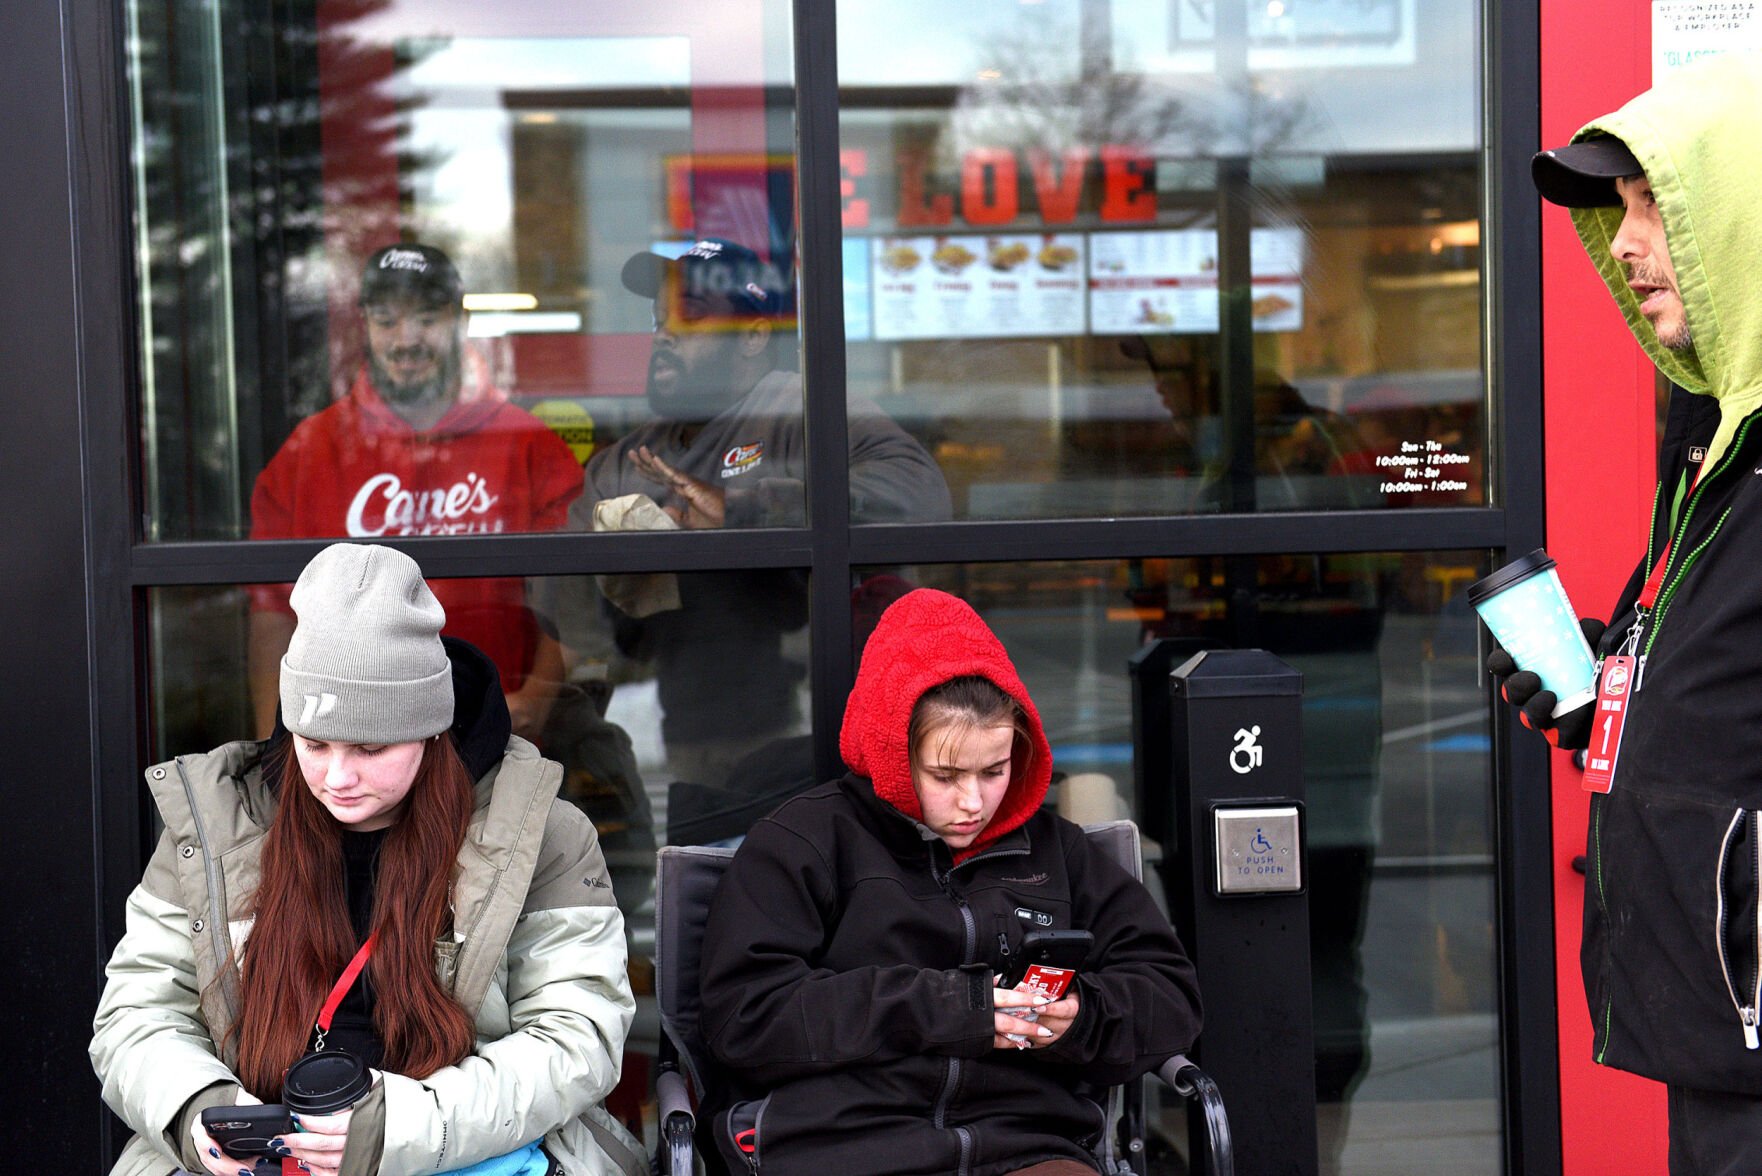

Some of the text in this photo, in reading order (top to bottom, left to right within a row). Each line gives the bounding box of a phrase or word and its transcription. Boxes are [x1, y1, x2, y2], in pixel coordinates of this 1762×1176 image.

[897, 146, 1158, 227] LOVE
[1401, 441, 1418, 452] Sun
[1426, 440, 1442, 452] Thu
[1376, 455, 1419, 466] 10:00am
[1427, 453, 1470, 465] 12:00am
[1404, 467, 1418, 479] Fri
[1424, 466, 1440, 478] Sat
[1380, 481, 1423, 493] 10:00am
[1431, 480, 1467, 492] 1:00am
[346, 472, 498, 538] Cane's
[1601, 715, 1613, 755] 1
[1246, 856, 1274, 865] PUSH
[1238, 866, 1284, 875] TO OPEN
